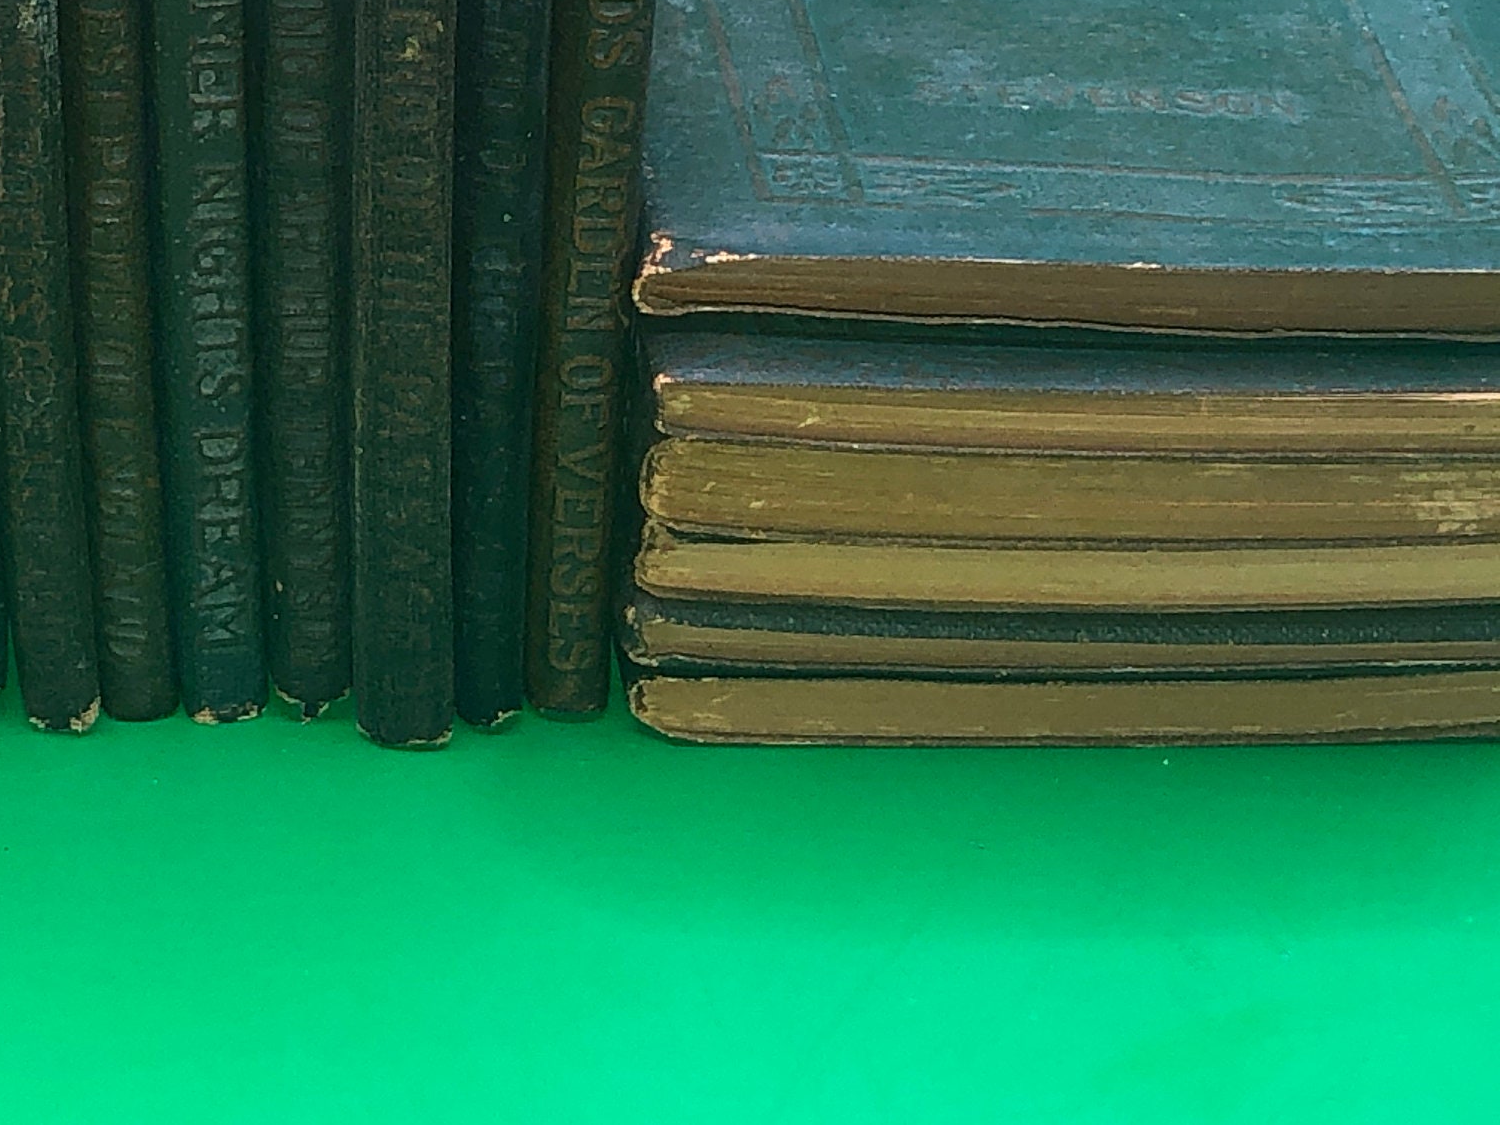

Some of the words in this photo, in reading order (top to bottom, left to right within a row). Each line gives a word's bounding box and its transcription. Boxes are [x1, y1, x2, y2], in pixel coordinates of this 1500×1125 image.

[84, 133, 137, 327] POEMS
[560, 95, 635, 333] GARDEN
[557, 354, 613, 430] OF
[189, 425, 251, 660] DREAM
[545, 439, 606, 673] VERSES
